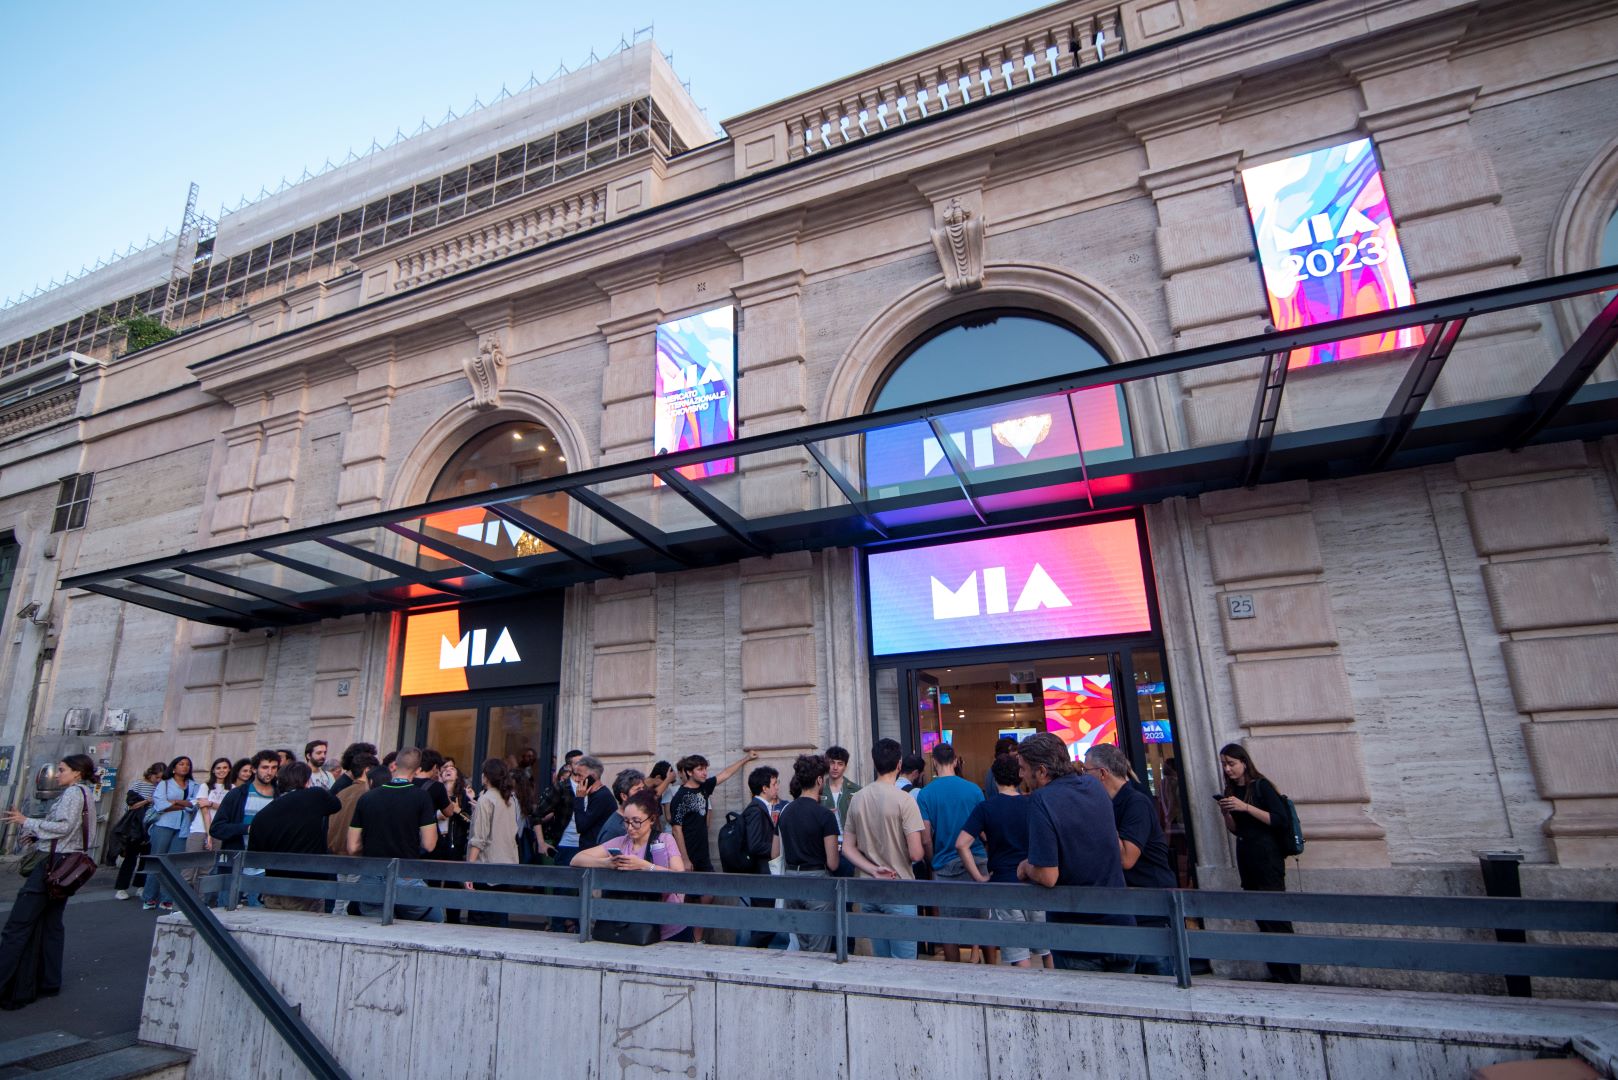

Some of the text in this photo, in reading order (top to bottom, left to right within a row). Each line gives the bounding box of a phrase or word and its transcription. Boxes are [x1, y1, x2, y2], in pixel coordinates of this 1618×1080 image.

[1271, 207, 1381, 252] MIA
[1280, 236, 1388, 281] 2023
[663, 361, 723, 392] MIA
[664, 391, 726, 409] TERNAZIONALE
[665, 402, 709, 417] DIOVISIVO
[931, 562, 1073, 620] MIA
[1231, 600, 1252, 613] 25
[439, 626, 521, 670] MIA
[338, 683, 348, 692] 24
[1144, 732, 1165, 740] 2023
